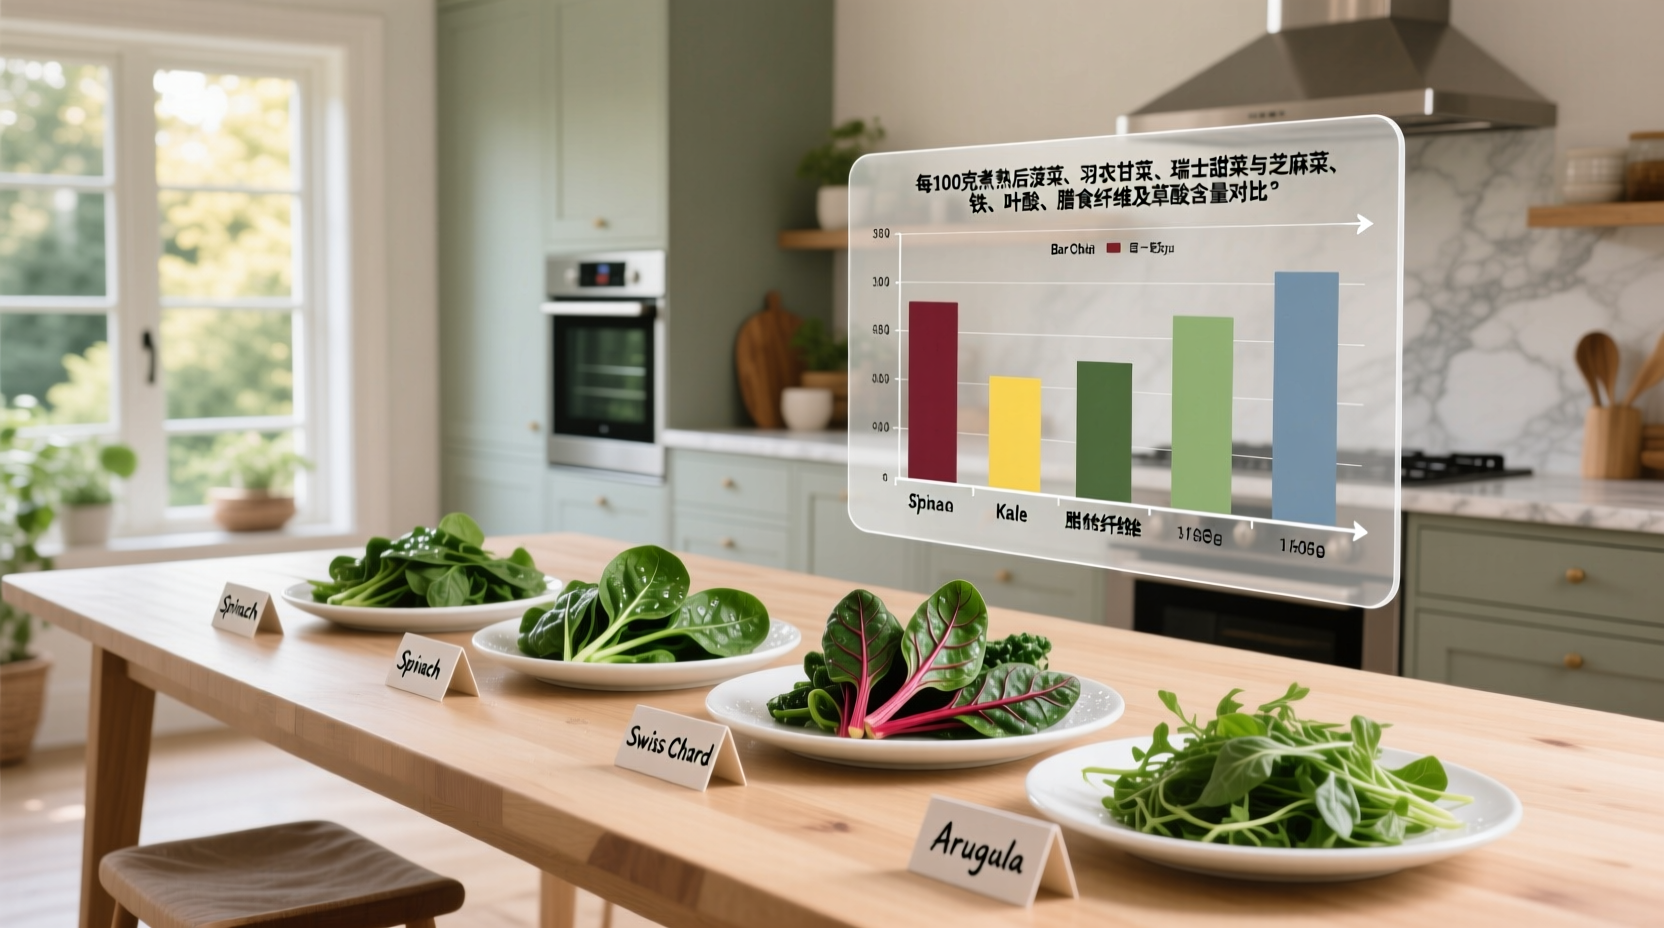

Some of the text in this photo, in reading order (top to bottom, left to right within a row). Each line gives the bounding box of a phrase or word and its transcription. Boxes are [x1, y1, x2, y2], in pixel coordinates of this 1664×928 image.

[1051, 243, 1069, 255] Bar
[996, 503, 1028, 522] Kale
[626, 725, 715, 766] Swiss Chard
[930, 821, 1024, 876] Arugula
